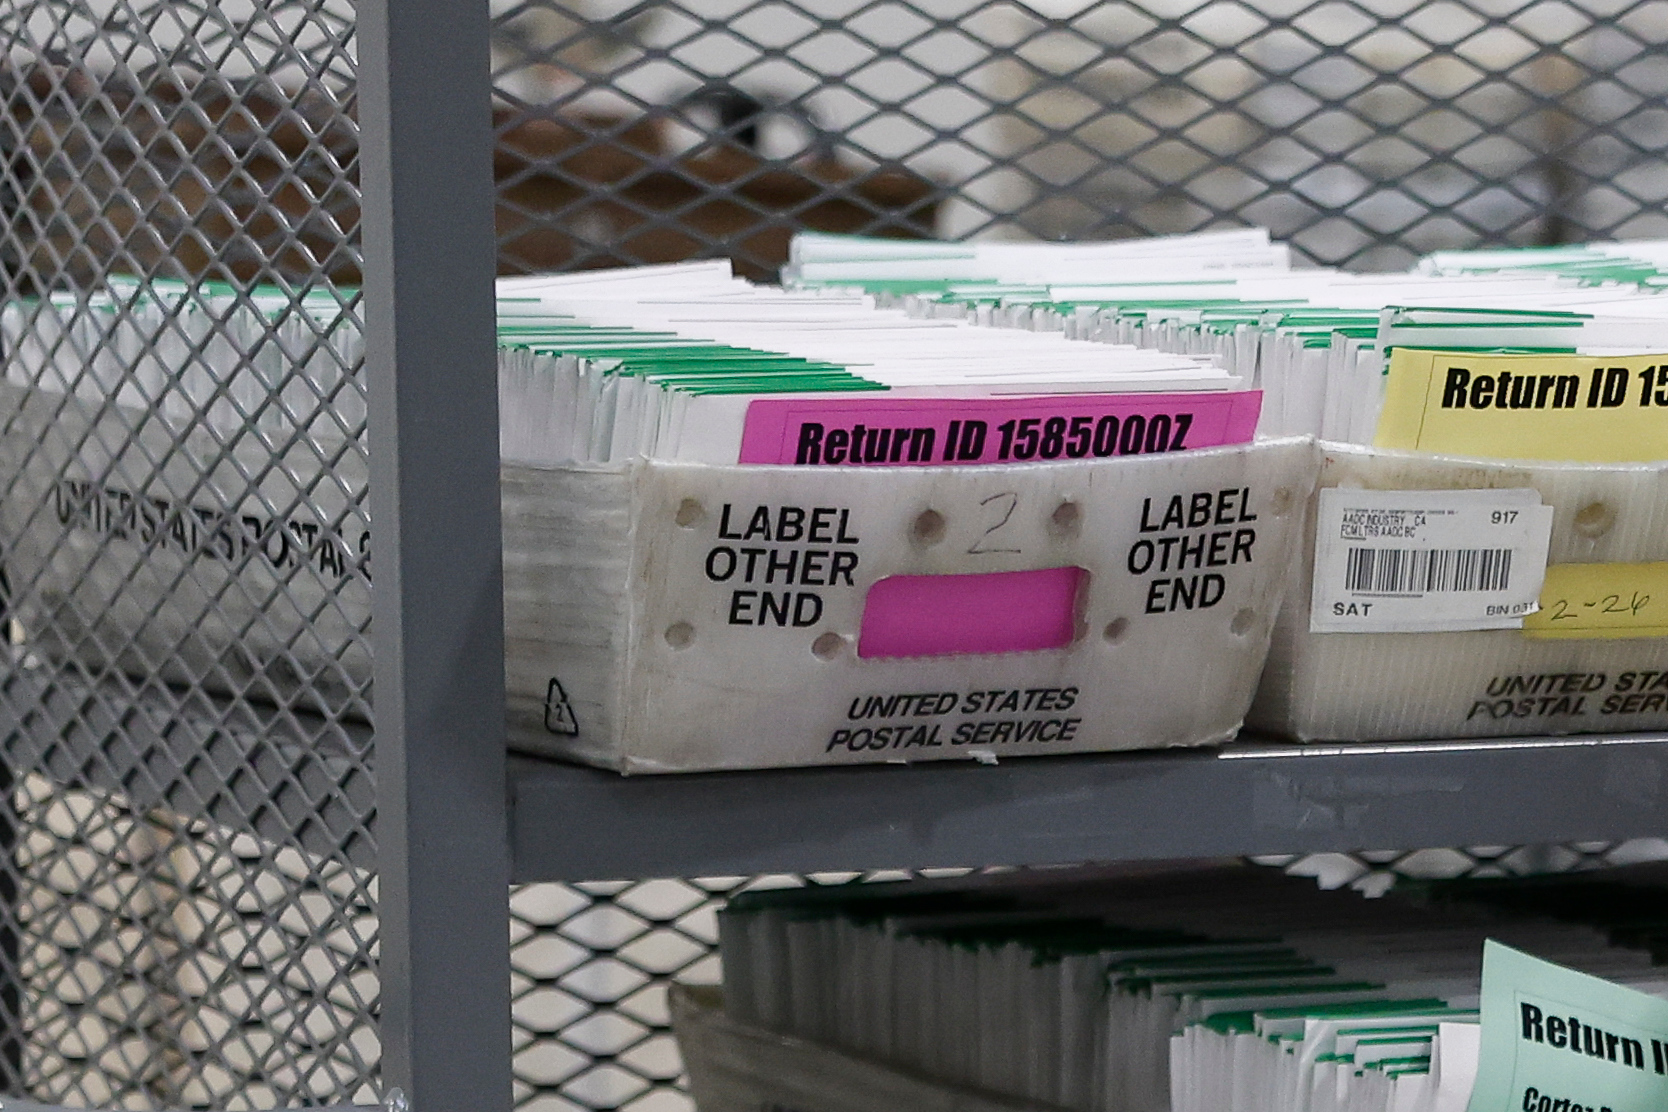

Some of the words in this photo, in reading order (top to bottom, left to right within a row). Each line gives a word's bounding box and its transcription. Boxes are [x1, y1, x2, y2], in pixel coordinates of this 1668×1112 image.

[1442, 369, 1578, 410] Return
[1586, 367, 1629, 408] ID
[796, 422, 936, 465] Return
[944, 420, 987, 461] ID
[997, 413, 1194, 461] 1585000Z
[718, 503, 860, 544] LABEL
[967, 492, 1021, 555] 2
[1139, 487, 1258, 533] LABEL
[1491, 511, 1519, 525] 917
[705, 546, 859, 587] OTHER
[1127, 529, 1256, 575] OTHER
[728, 590, 823, 628] END
[1144, 574, 1227, 615] END
[1333, 602, 1373, 617] SAT
[1487, 605, 1509, 616] BIN
[847, 693, 958, 720] UNITED
[961, 687, 1080, 715] STATES
[1486, 673, 1607, 696] UNITED
[1466, 697, 1588, 721] POSTAL
[826, 724, 942, 753] POSTAL
[951, 718, 1082, 747] SERVICE
[1520, 1002, 1645, 1070] Return
